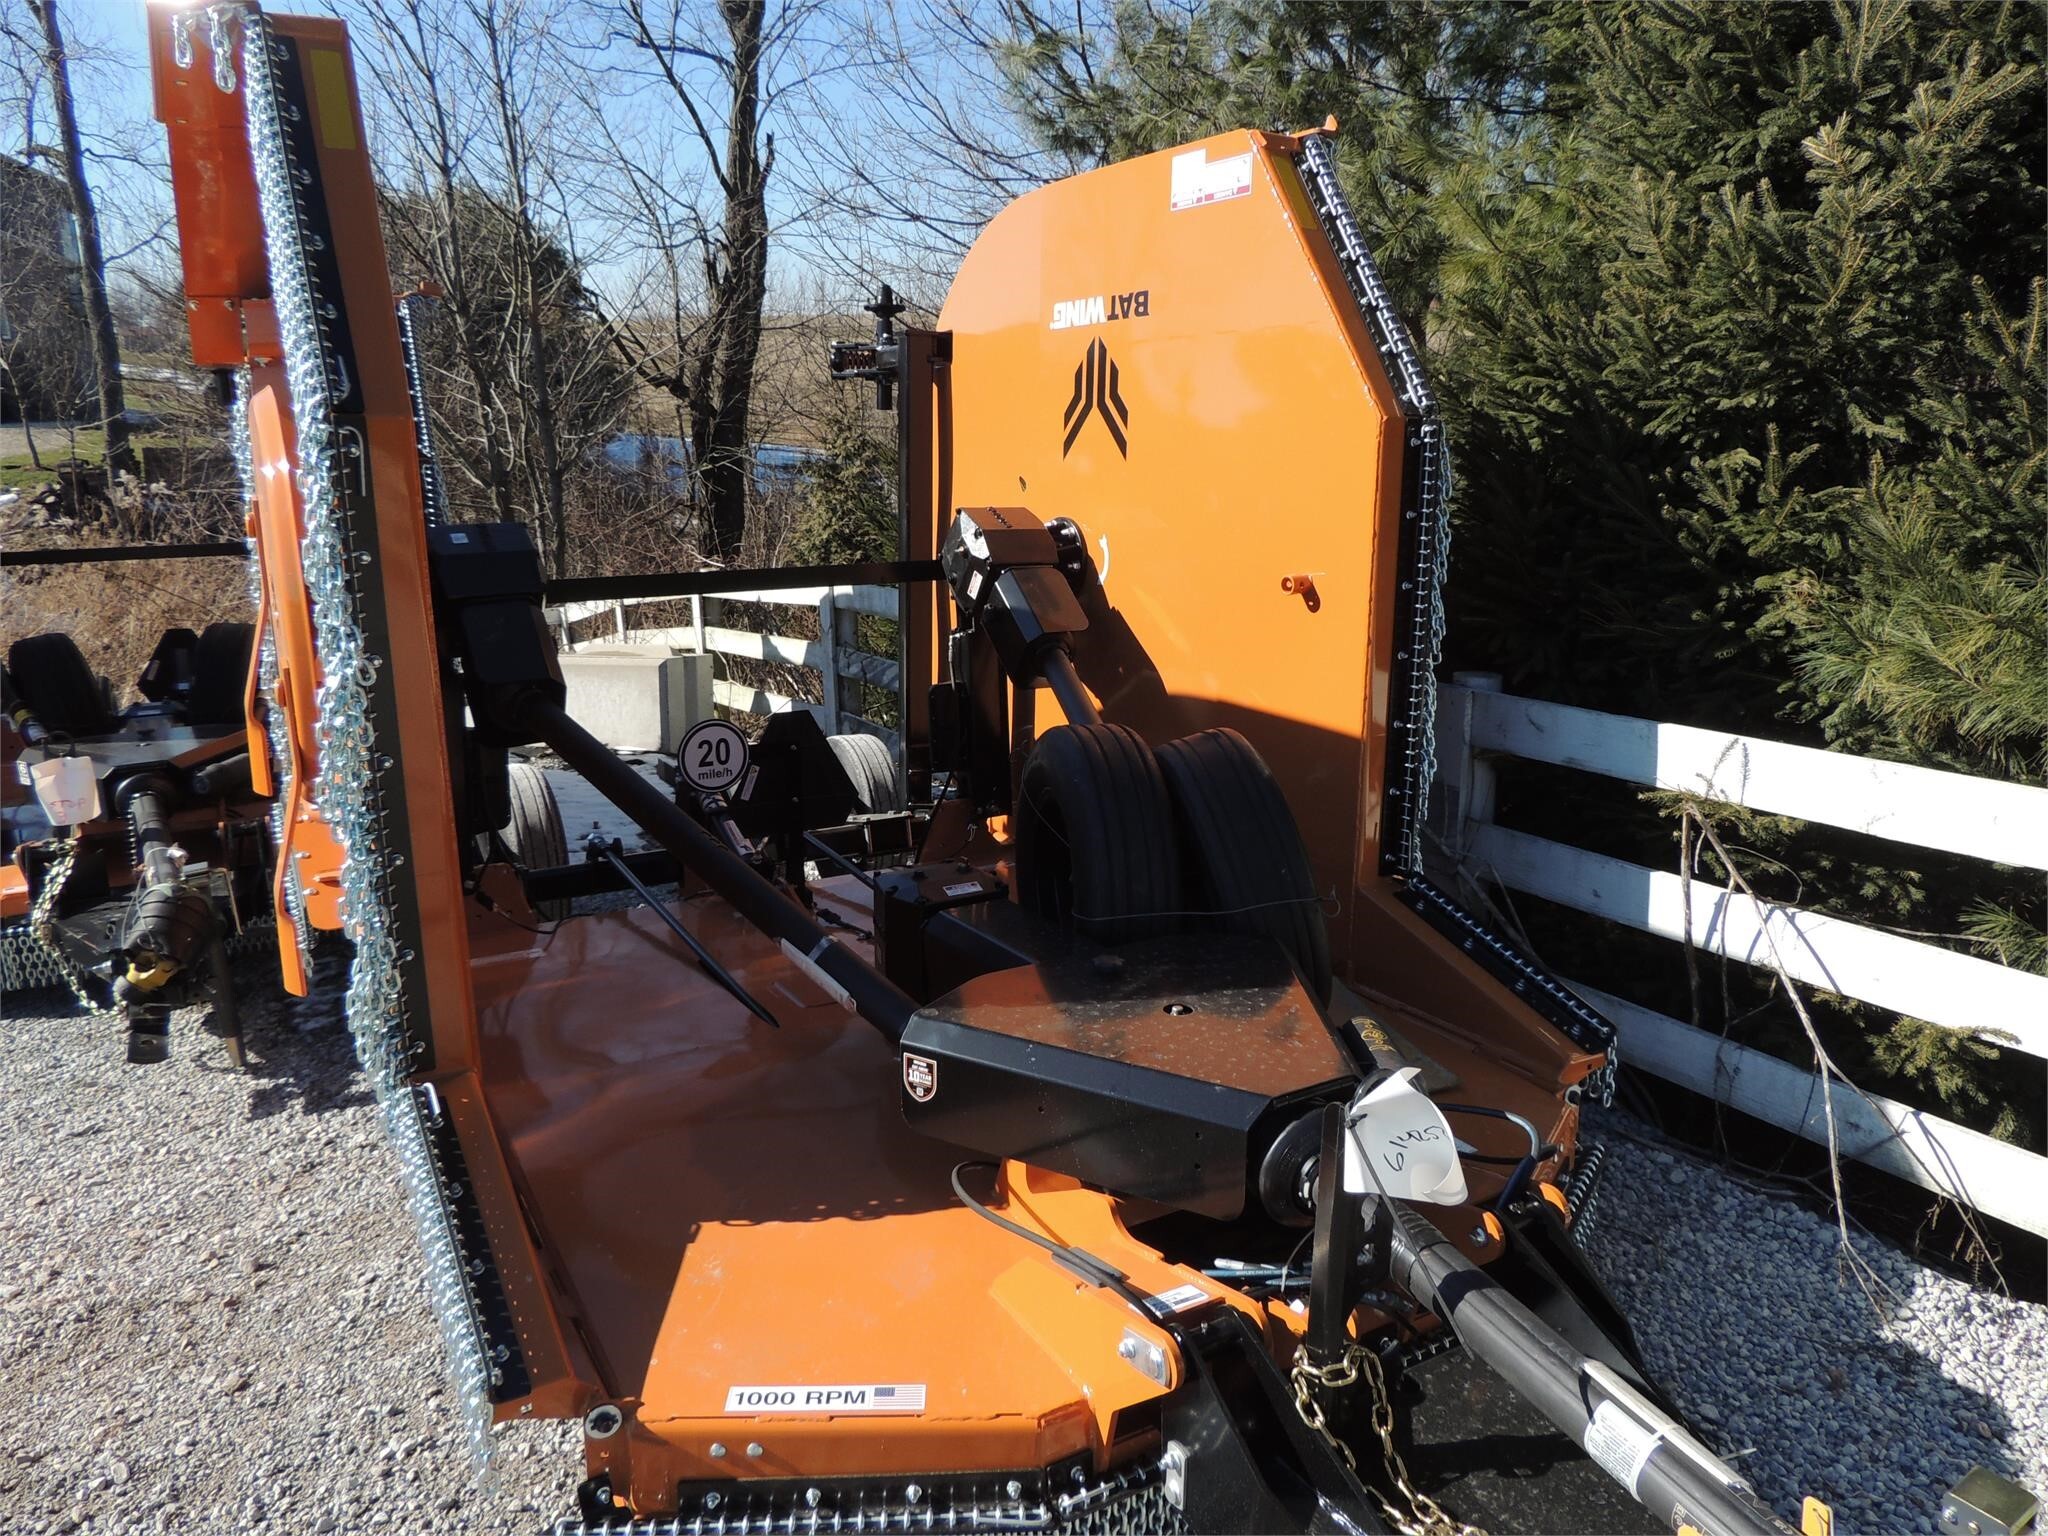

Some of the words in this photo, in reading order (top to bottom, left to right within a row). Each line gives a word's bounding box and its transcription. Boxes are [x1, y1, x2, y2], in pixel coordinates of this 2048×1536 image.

[697, 738, 731, 768] 20
[697, 767, 734, 780] mile/h
[735, 1391, 796, 1407] 1000
[804, 1390, 867, 1406] RPM
